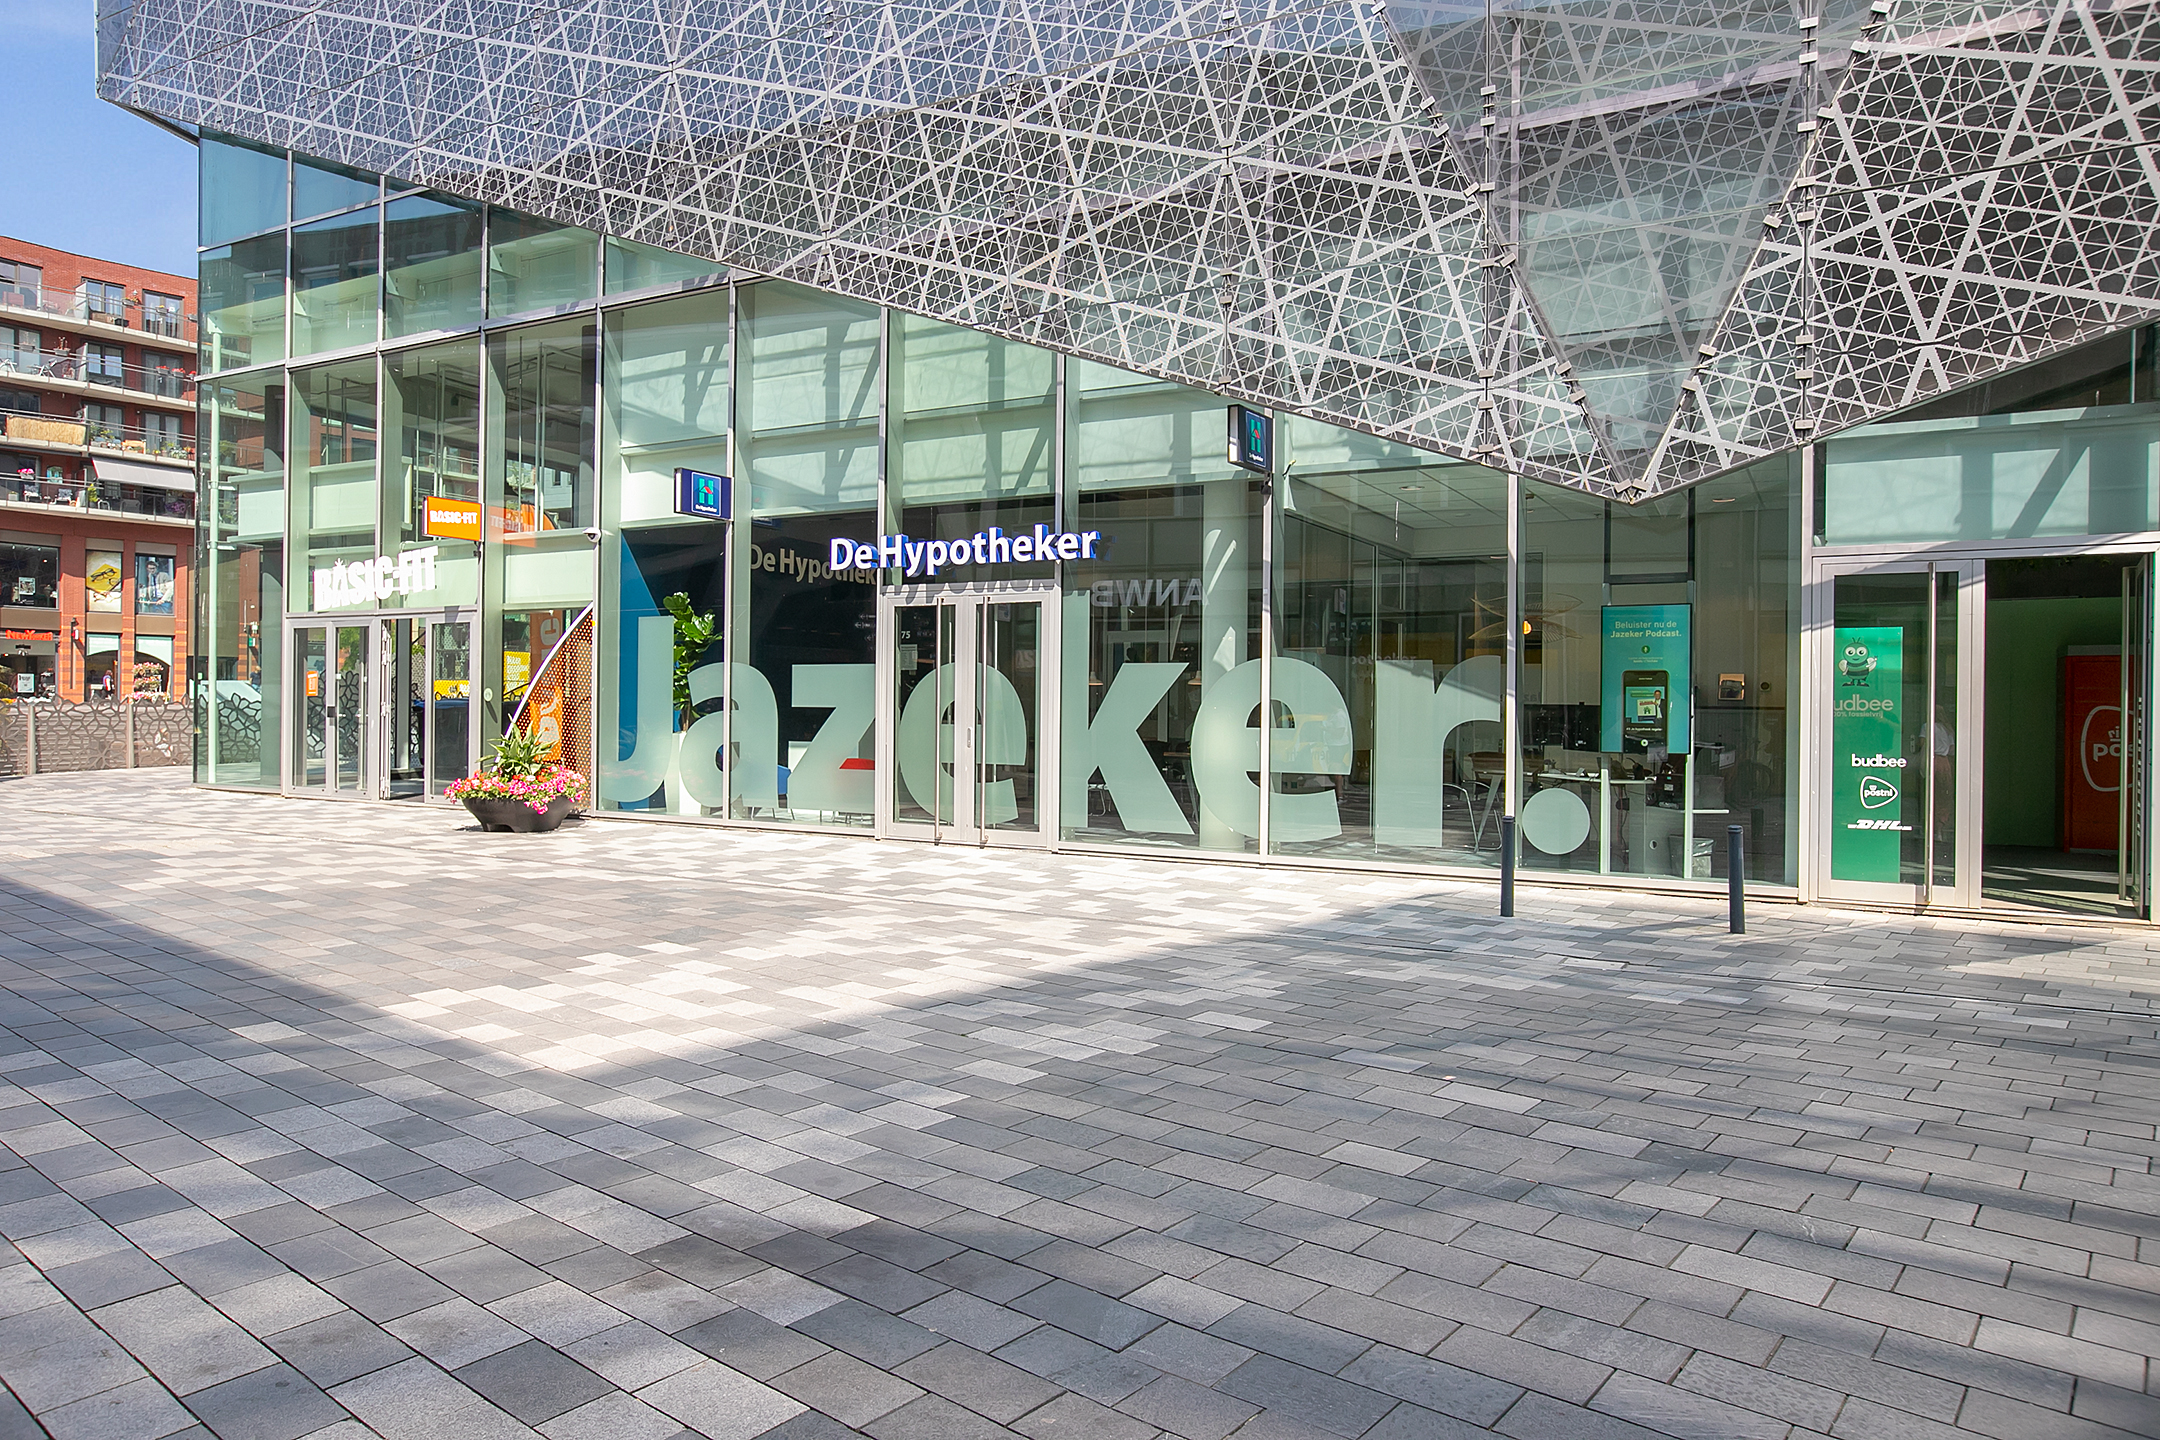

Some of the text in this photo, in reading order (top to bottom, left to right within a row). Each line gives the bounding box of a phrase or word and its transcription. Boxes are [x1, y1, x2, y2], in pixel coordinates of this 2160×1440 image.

[830, 523, 1101, 578] De Hypotheker
[1614, 621, 1652, 629] Beluister
[1666, 620, 1677, 628] de
[1610, 629, 1682, 638] Jazeker Podcast.
[601, 614, 1592, 854] Jazeker.
[1851, 753, 1907, 768] budbee
[1864, 788, 1894, 799] postnl
[1853, 819, 1905, 831] DHL
